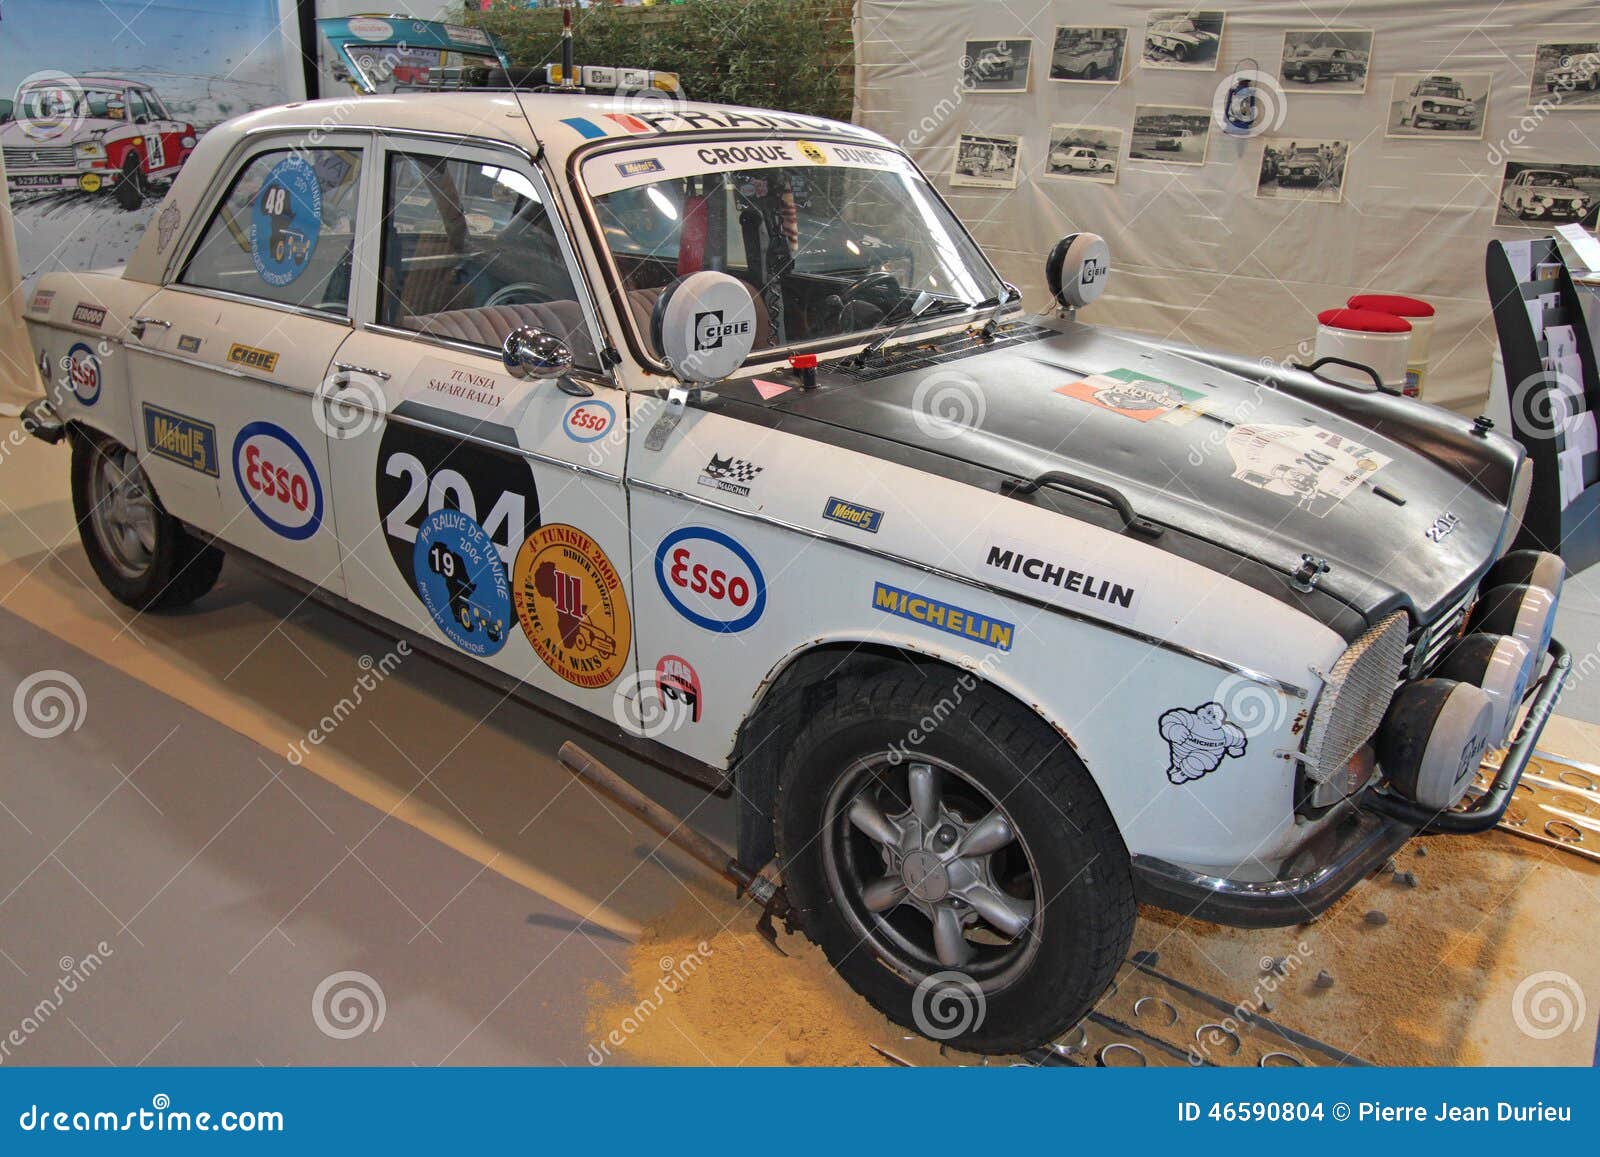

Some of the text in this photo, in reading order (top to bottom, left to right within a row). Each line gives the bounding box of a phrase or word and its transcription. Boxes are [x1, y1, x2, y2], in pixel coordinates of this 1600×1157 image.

[697, 146, 888, 167] CROQUE DUNES
[265, 188, 286, 215] 48
[705, 322, 750, 339] CIBIE
[427, 379, 504, 407] SAFARI RALLY
[451, 369, 496, 390] TUNISIA
[571, 408, 606, 432] ESSO
[246, 445, 309, 512] ESSO
[384, 452, 526, 582] 204
[431, 548, 455, 577] 19
[432, 513, 467, 534] RALLYE
[468, 524, 484, 544] DE
[482, 541, 509, 600] TUNISIE
[460, 537, 482, 565] 2006
[540, 528, 592, 552] TUNISIE
[592, 551, 620, 591] 2009
[563, 549, 592, 573] DIDIER
[671, 548, 749, 607] ESSO
[986, 546, 1135, 609] MICHELIN
[876, 587, 1013, 646] MICHELIN
[558, 664, 614, 686] HISTORIQUE
[569, 653, 602, 674] WAYS
[1188, 737, 1225, 749] MICHELIN
